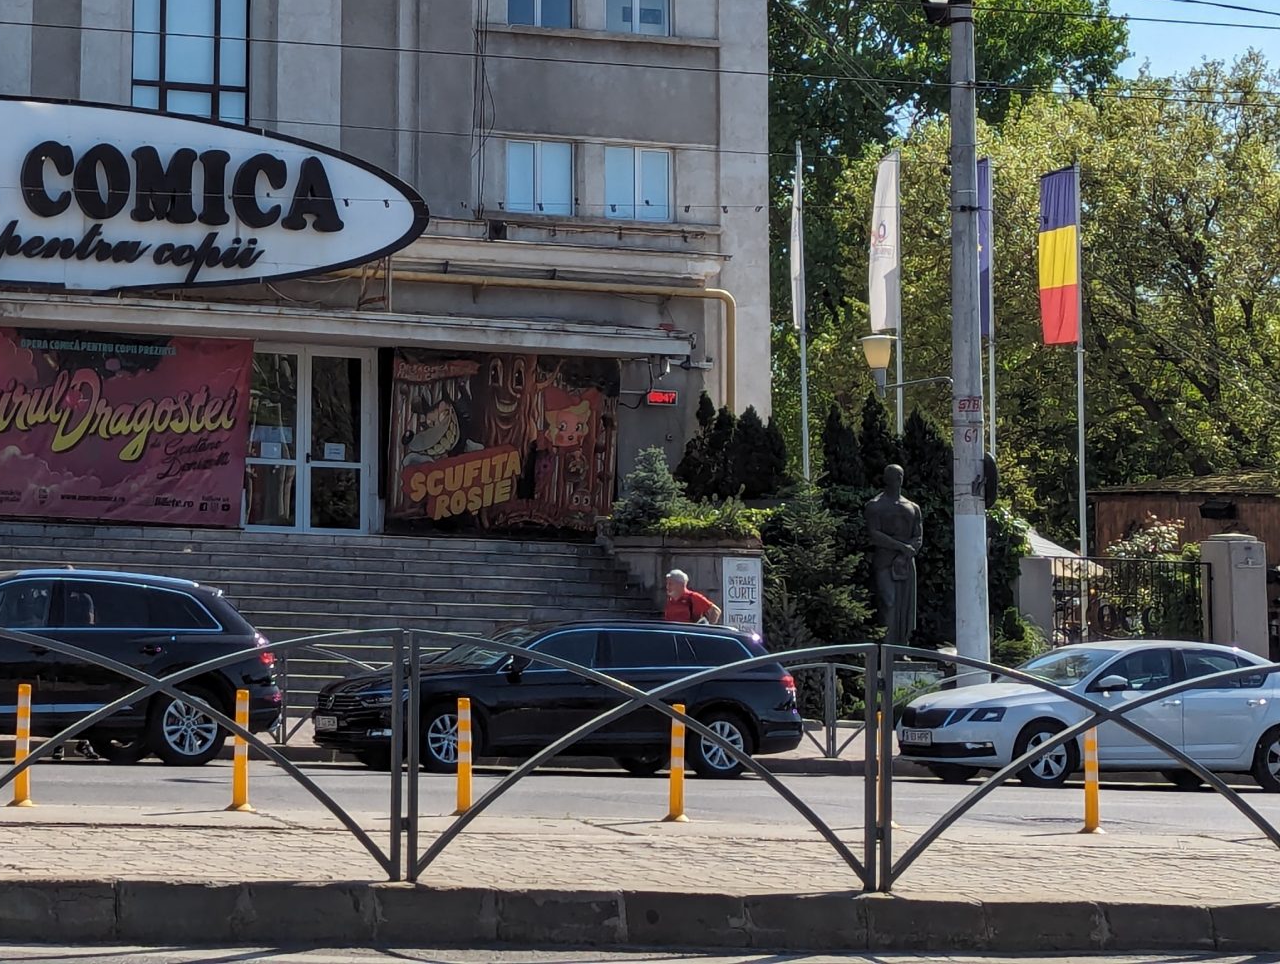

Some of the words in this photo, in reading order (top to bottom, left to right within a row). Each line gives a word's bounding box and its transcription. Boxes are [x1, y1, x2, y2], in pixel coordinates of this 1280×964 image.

[20, 140, 345, 232] COMICA
[153, 229, 266, 285] copii
[20, 338, 48, 349] OPERA
[81, 341, 114, 353] PENTRU
[51, 367, 238, 461] Dragostei
[728, 576, 757, 587] INTRARE
[728, 586, 757, 601] CURTE
